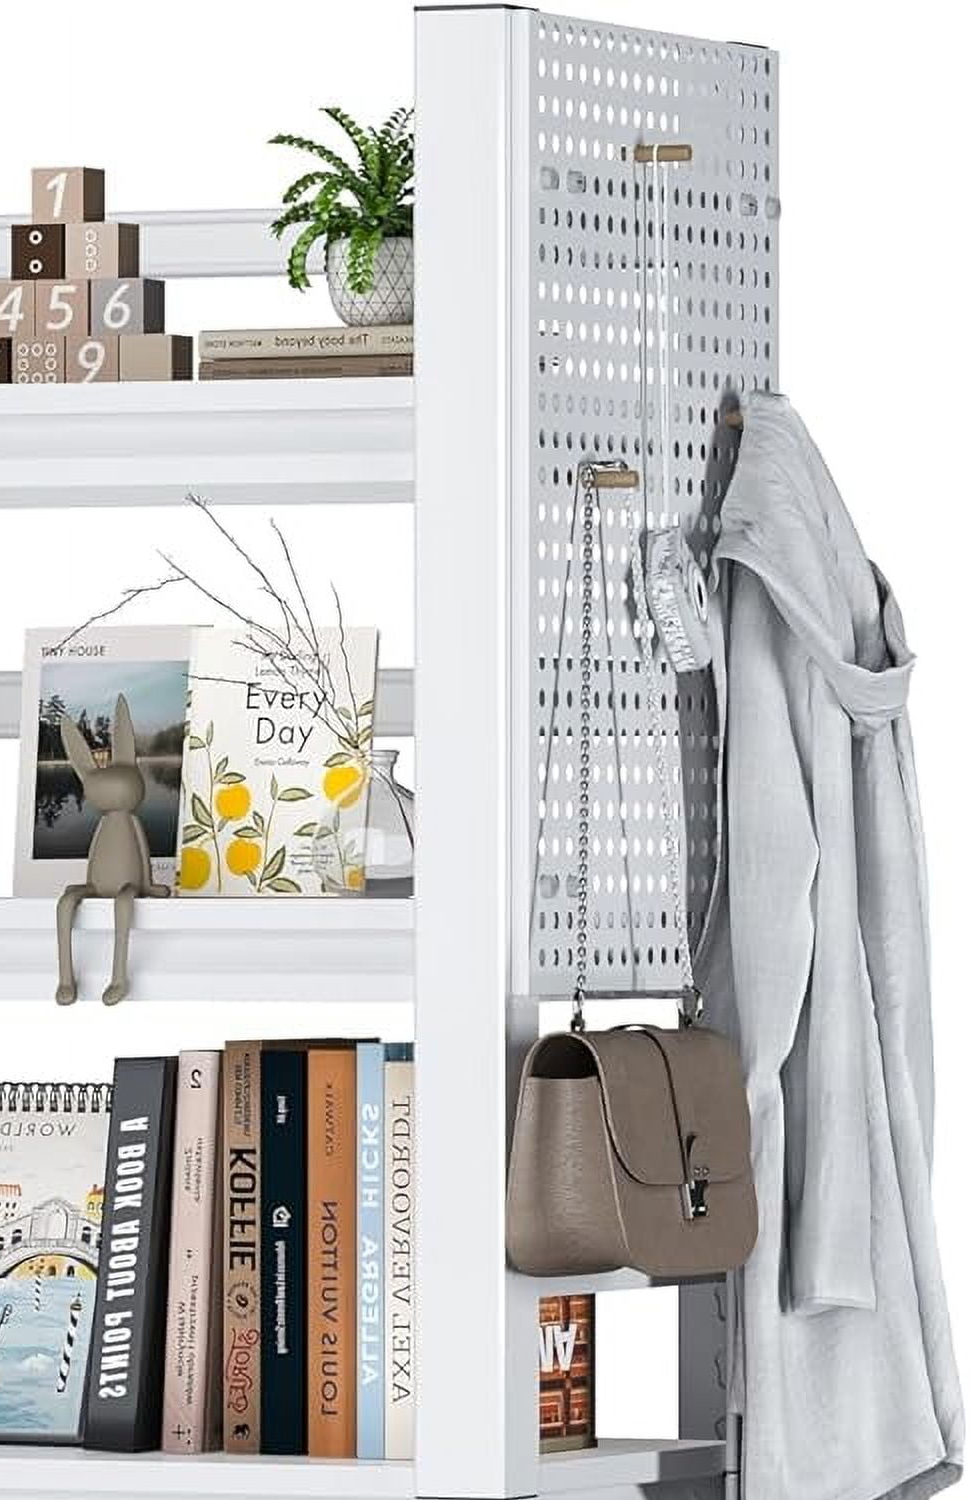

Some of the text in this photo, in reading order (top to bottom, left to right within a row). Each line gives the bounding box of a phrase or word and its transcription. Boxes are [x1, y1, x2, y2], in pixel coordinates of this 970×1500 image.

[46, 172, 68, 218] 1
[45, 284, 77, 330] 5
[102, 283, 131, 329] 6
[77, 341, 106, 383] 9
[246, 682, 328, 718] Every
[256, 717, 314, 753] Day
